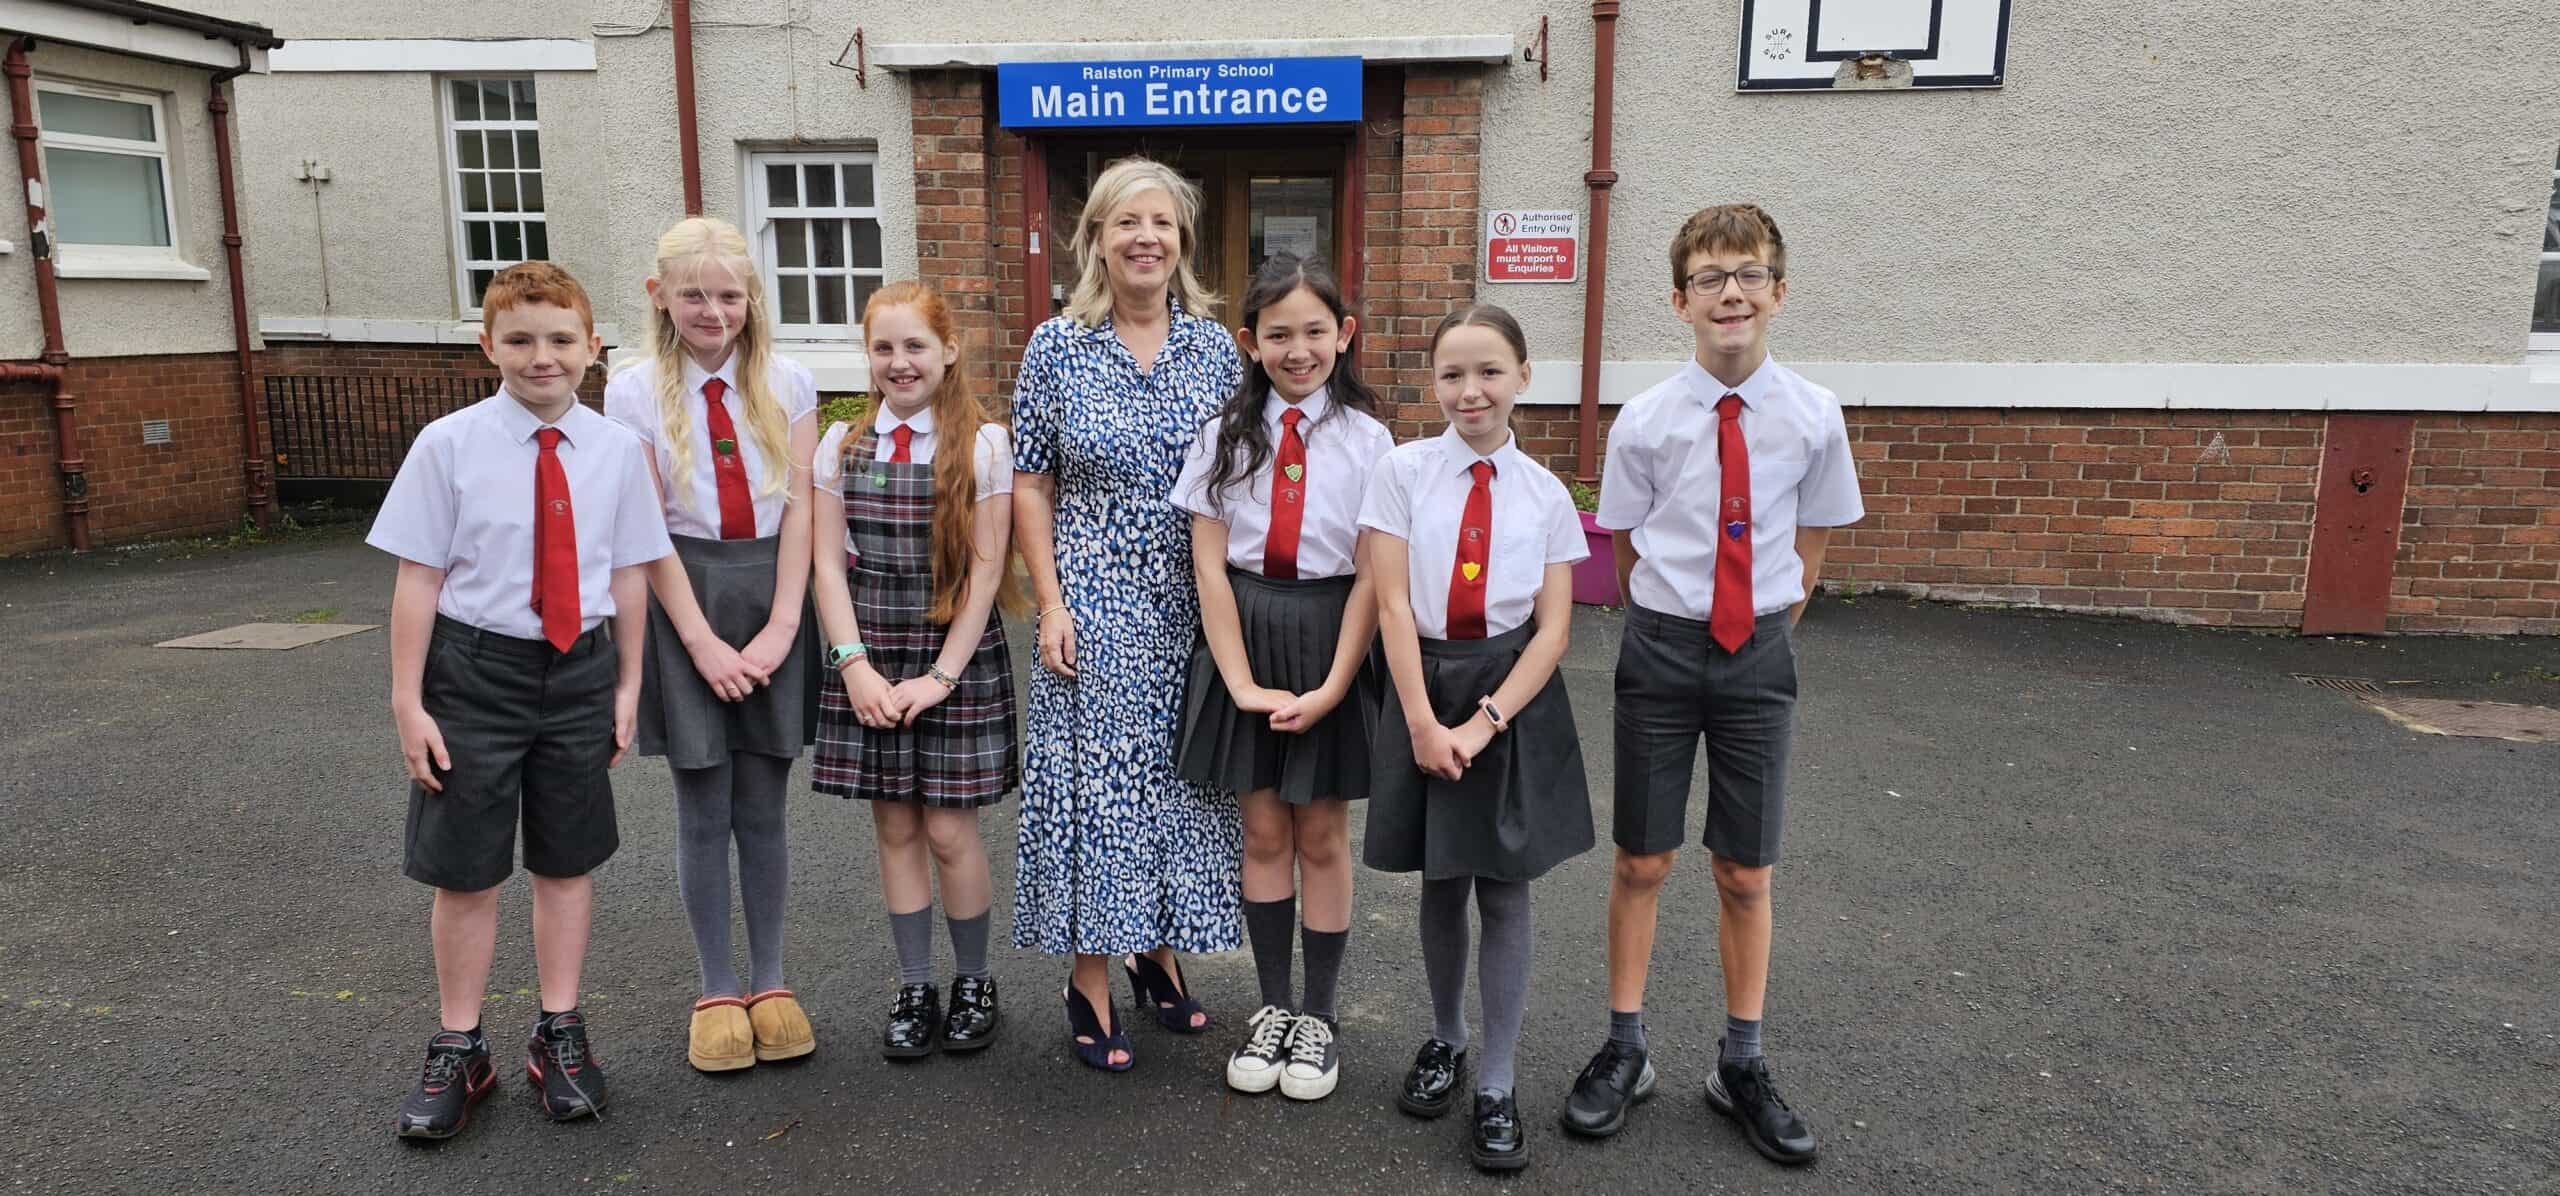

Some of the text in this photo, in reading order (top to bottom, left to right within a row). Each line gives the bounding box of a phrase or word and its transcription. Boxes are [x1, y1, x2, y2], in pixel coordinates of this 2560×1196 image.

[1082, 63, 1274, 80] Ralston Primary School
[1031, 81, 1329, 118] Main Entrance
[1521, 213, 1573, 221] Authorised
[1521, 224, 1571, 234] Entry Only
[1505, 244, 1559, 253] All Visitors
[1496, 254, 1567, 265] must report to
[1507, 264, 1554, 274] Enquiries
